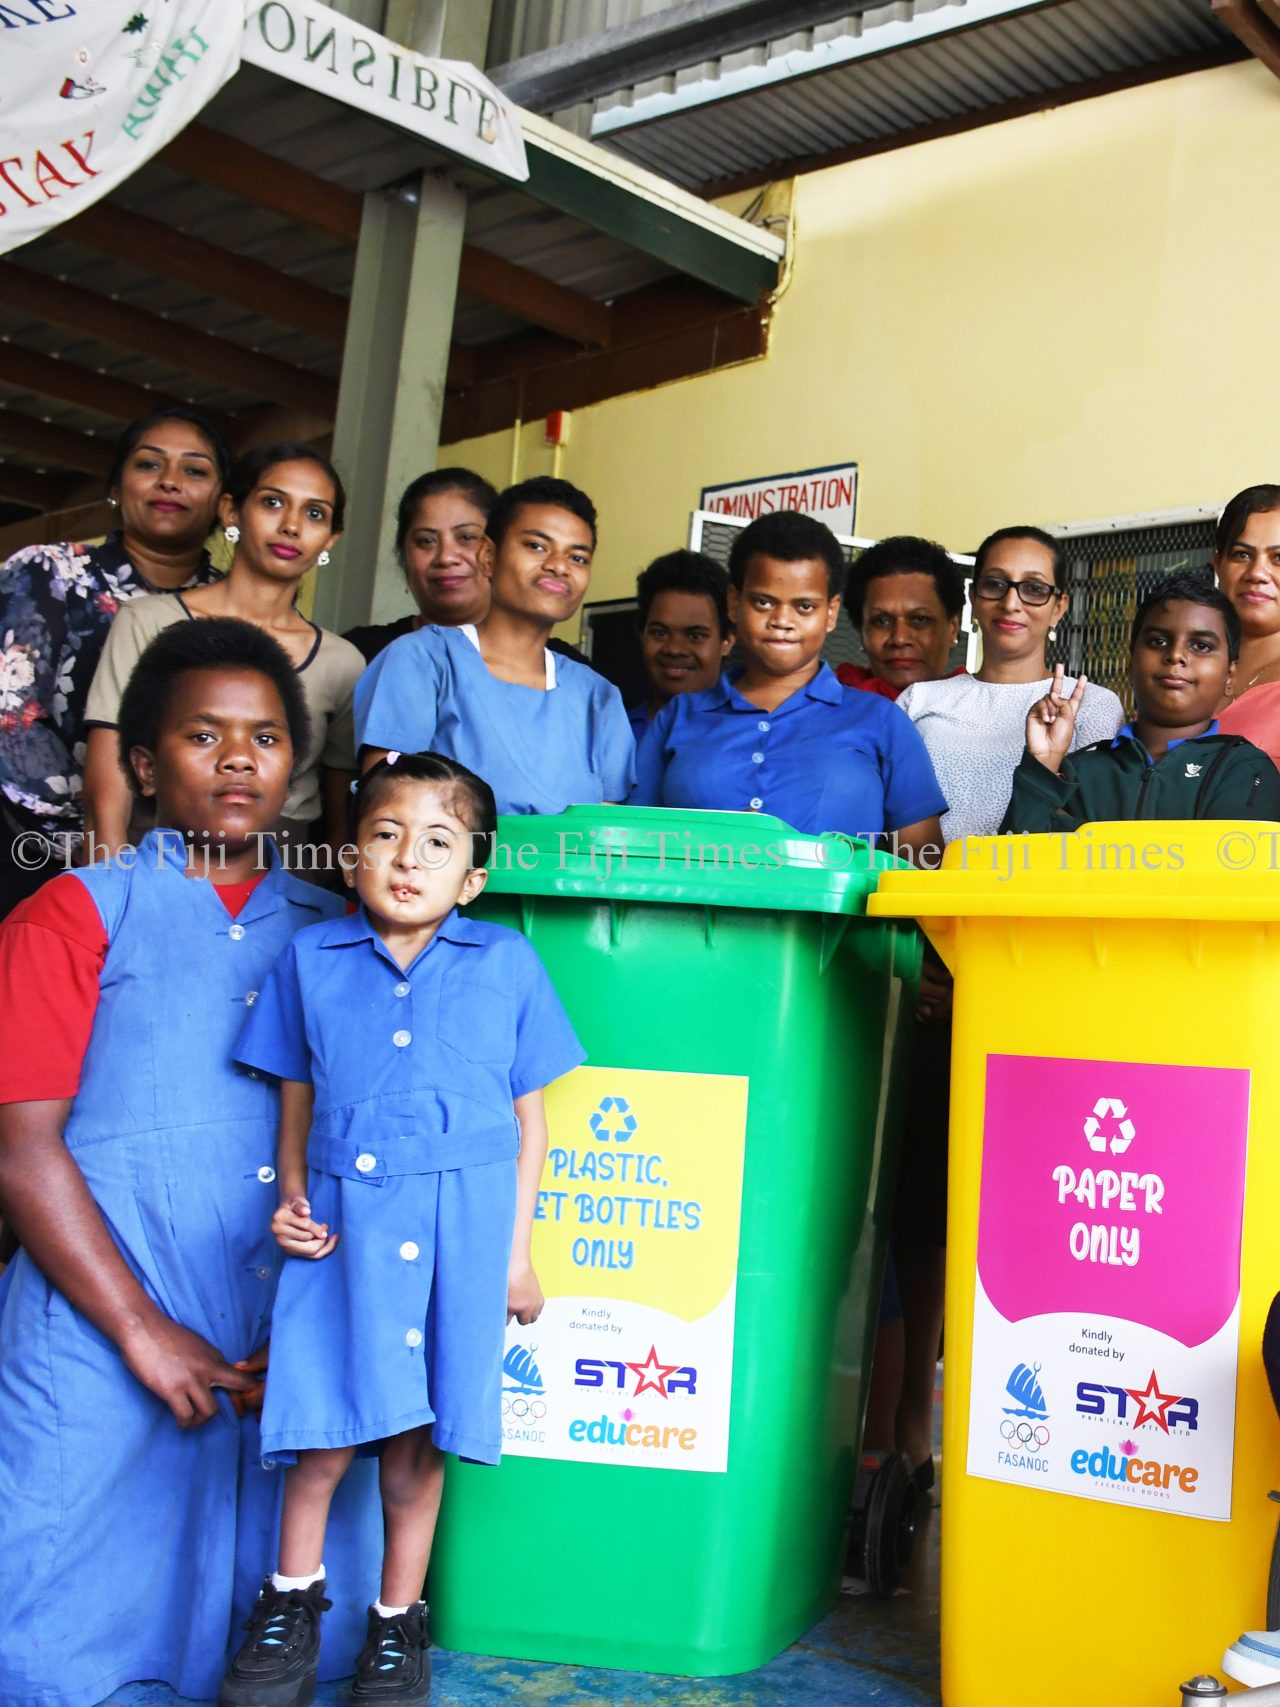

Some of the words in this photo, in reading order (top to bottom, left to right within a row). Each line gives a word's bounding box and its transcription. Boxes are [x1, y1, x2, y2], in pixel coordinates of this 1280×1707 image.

[0, 130, 103, 217] TAY
[1052, 1165, 1165, 1214] PAPER
[533, 1190, 568, 1221] ET
[574, 1193, 702, 1230] BOTTLES
[572, 1237, 634, 1269] ONLY
[1069, 1222, 1140, 1267] ONLY
[581, 1308, 612, 1319] Kindly
[569, 1321, 609, 1332] donated
[611, 1323, 623, 1334] by
[1081, 1328, 1113, 1344] Kindly
[1068, 1343, 1110, 1358] donated
[1112, 1347, 1125, 1361] by
[501, 1428, 546, 1443] ASANOC
[569, 1414, 697, 1451] educare
[997, 1451, 1049, 1473] FASANOC
[1070, 1445, 1199, 1493] educare
[1095, 1481, 1136, 1493] EXERCISE
[1142, 1488, 1170, 1499] BOOKS
